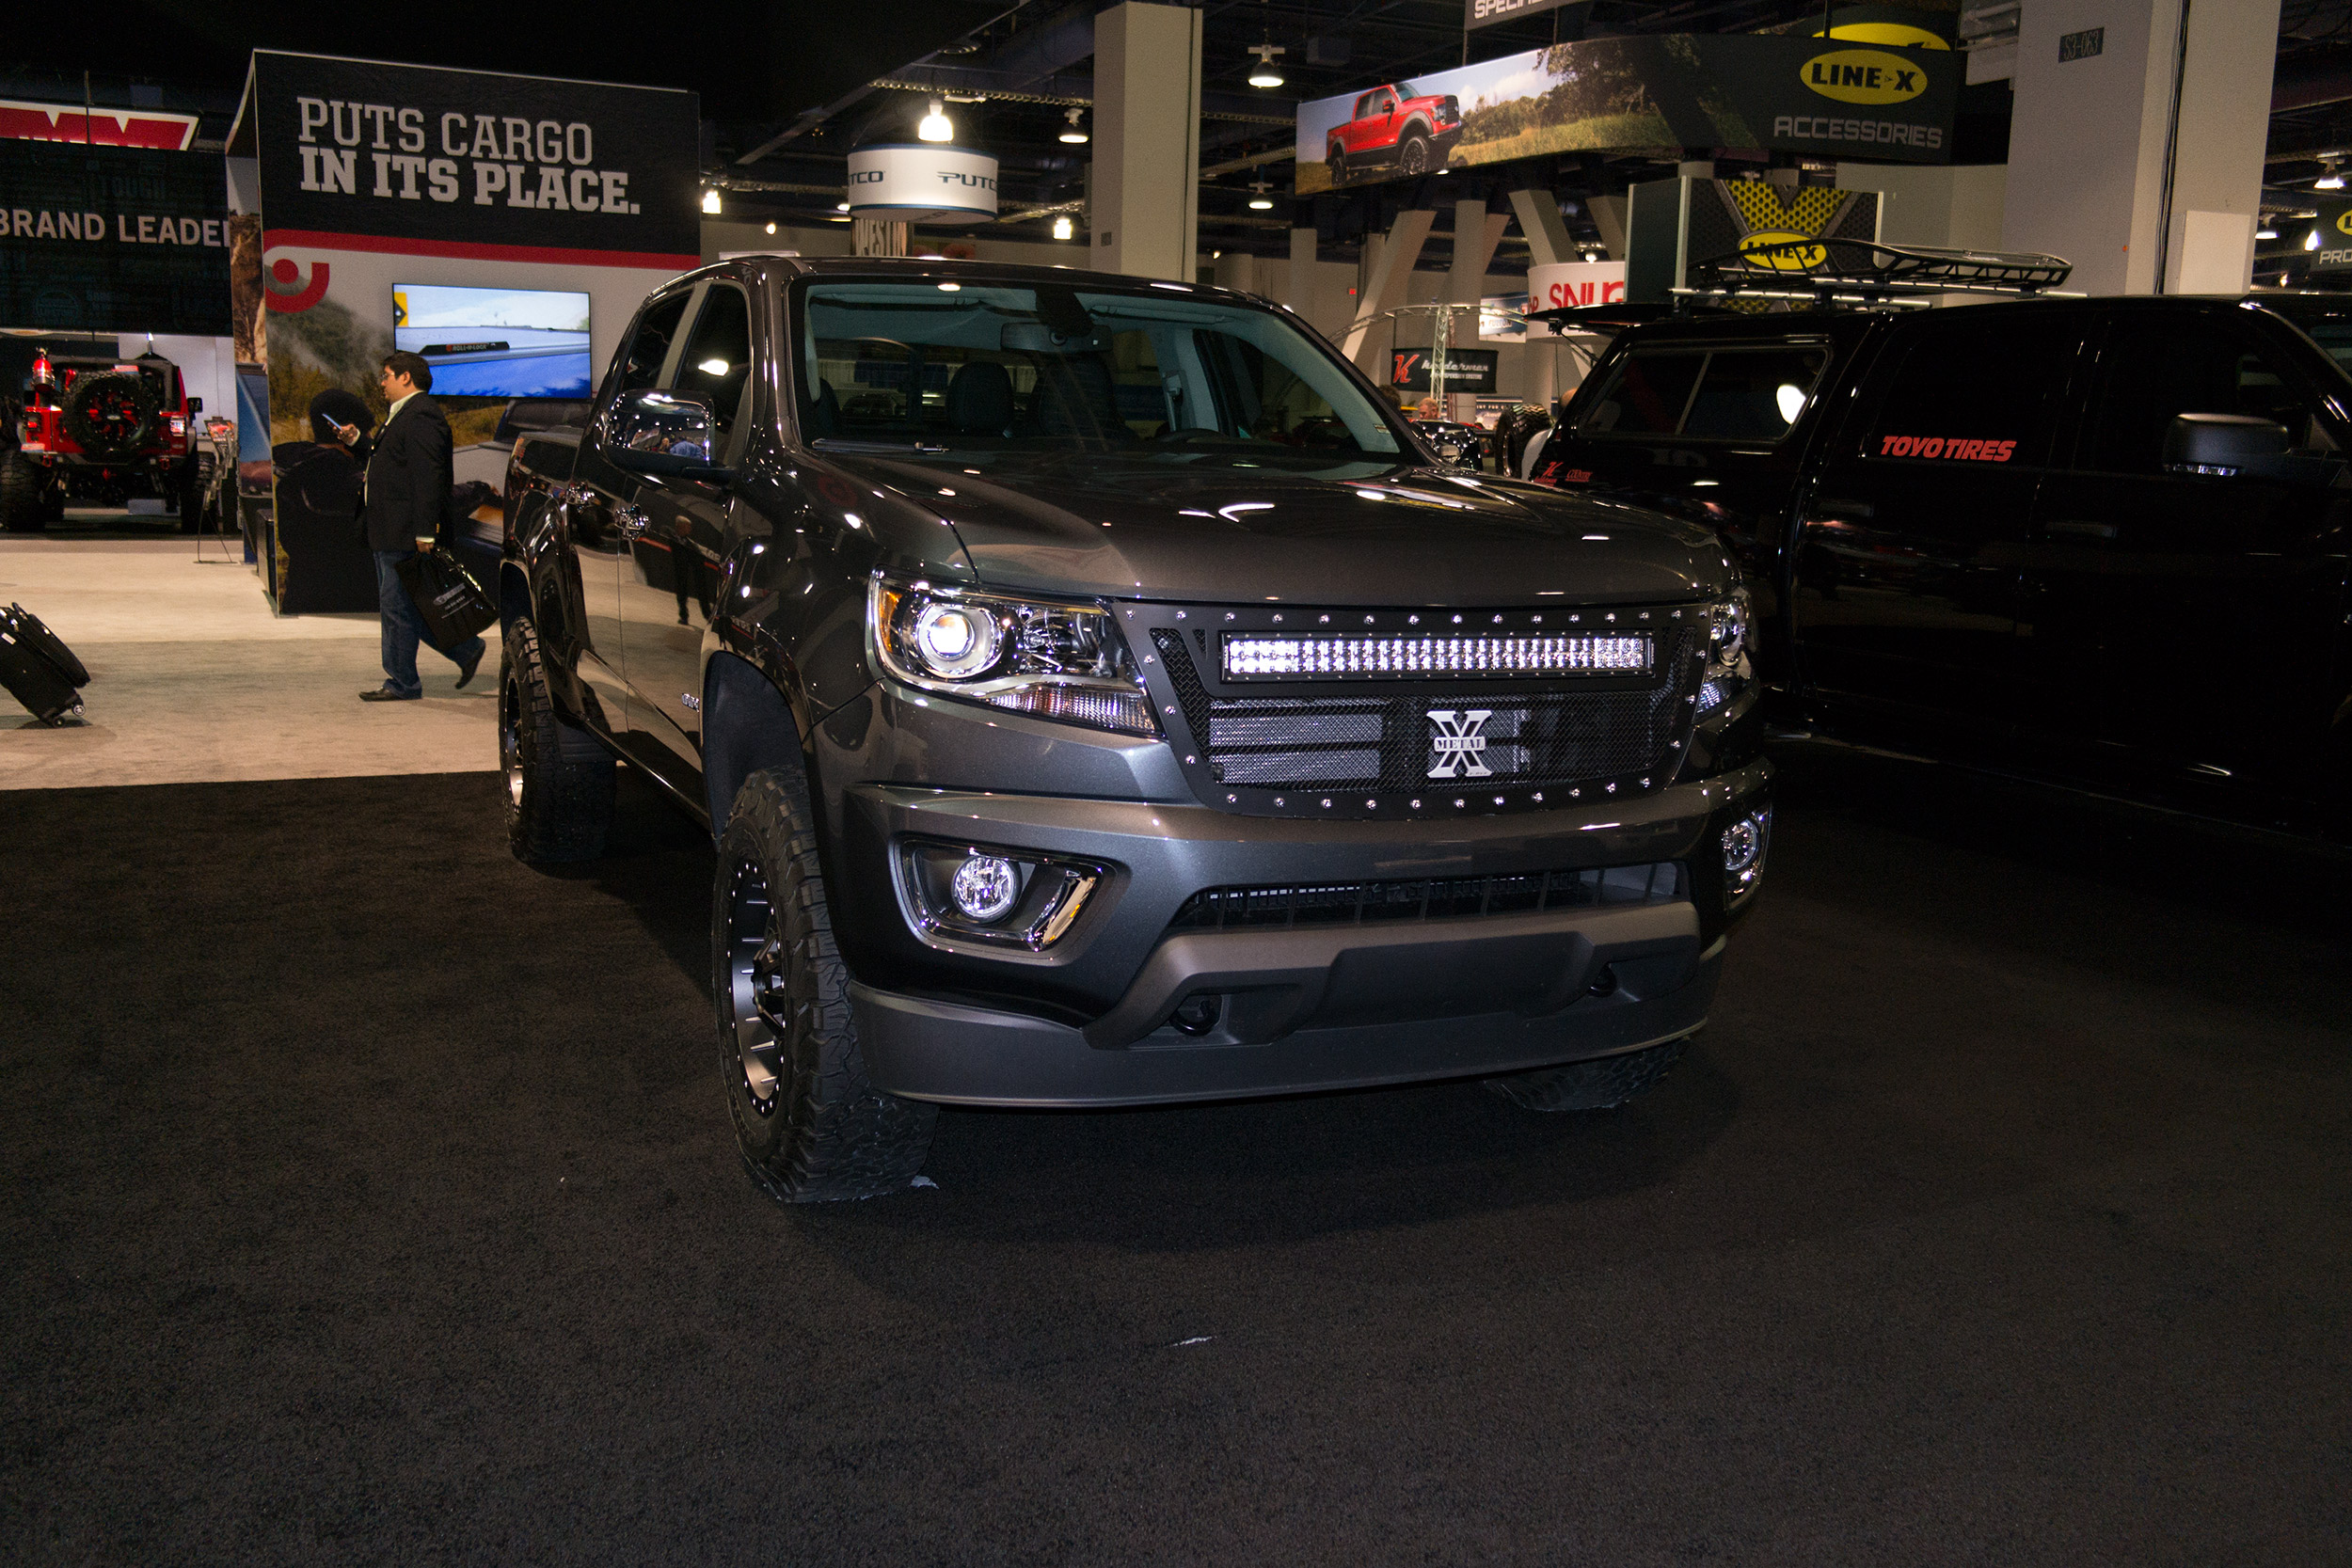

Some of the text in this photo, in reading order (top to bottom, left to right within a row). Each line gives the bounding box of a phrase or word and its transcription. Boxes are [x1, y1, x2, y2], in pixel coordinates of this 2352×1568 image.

[296, 97, 593, 166] PUTS CARGO
[1773, 116, 1943, 150] ACCESSORIES
[298, 146, 641, 214] IN ITS PLACE.
[849, 170, 884, 185] TCO
[937, 171, 998, 191] PUTC
[1437, 738, 1484, 750] METAL
